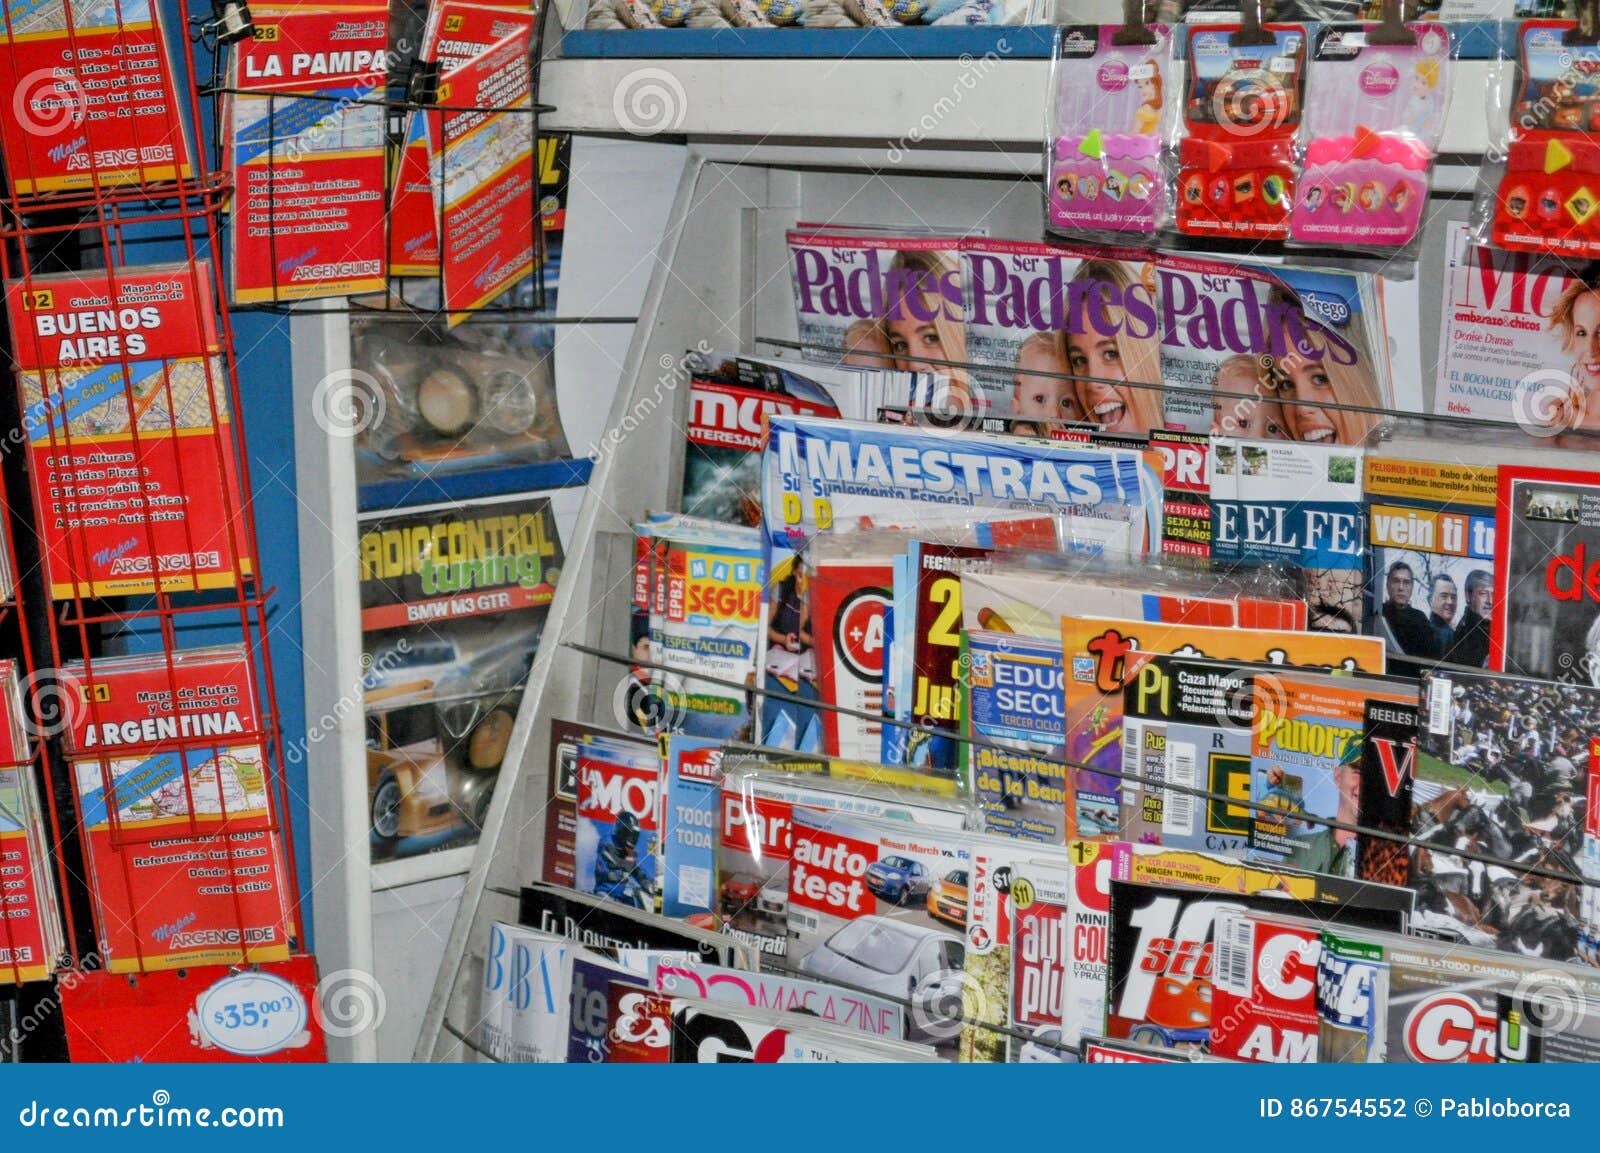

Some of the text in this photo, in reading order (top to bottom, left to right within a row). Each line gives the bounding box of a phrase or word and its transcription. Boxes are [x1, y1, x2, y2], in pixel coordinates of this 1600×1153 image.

[246, 50, 387, 78] LA PAMPA
[831, 246, 857, 265] Ser
[1012, 254, 1040, 273] Ser
[291, 260, 382, 282] ARGENGUIDE
[791, 247, 965, 323] Padres
[1201, 273, 1231, 294] Ser
[967, 252, 1157, 340] Padres
[36, 306, 162, 338] BUENOS
[58, 333, 147, 361] AIRES
[1449, 385, 1465, 394] SIN
[805, 437, 1103, 506] MAESTRAS
[1166, 516, 1191, 528] SEXO
[1374, 512, 1463, 553] vein ti
[1167, 529, 1185, 538] LOS
[421, 549, 542, 594] tuning
[407, 592, 512, 622] BMW M3 GTR
[668, 578, 683, 618] EPB2
[198, 684, 237, 697] Rutas
[1178, 670, 1245, 690] Caza Mayor
[1000, 713, 1062, 731] TERCER CICLO
[1369, 707, 1413, 726] REELES
[793, 836, 868, 878] auto
[880, 837, 907, 851] Nissan
[909, 843, 940, 857] March
[134, 853, 206, 867] Referencias
[1175, 870, 1204, 882] TUNING
[791, 864, 863, 912] test
[1075, 912, 1108, 927] MINI
